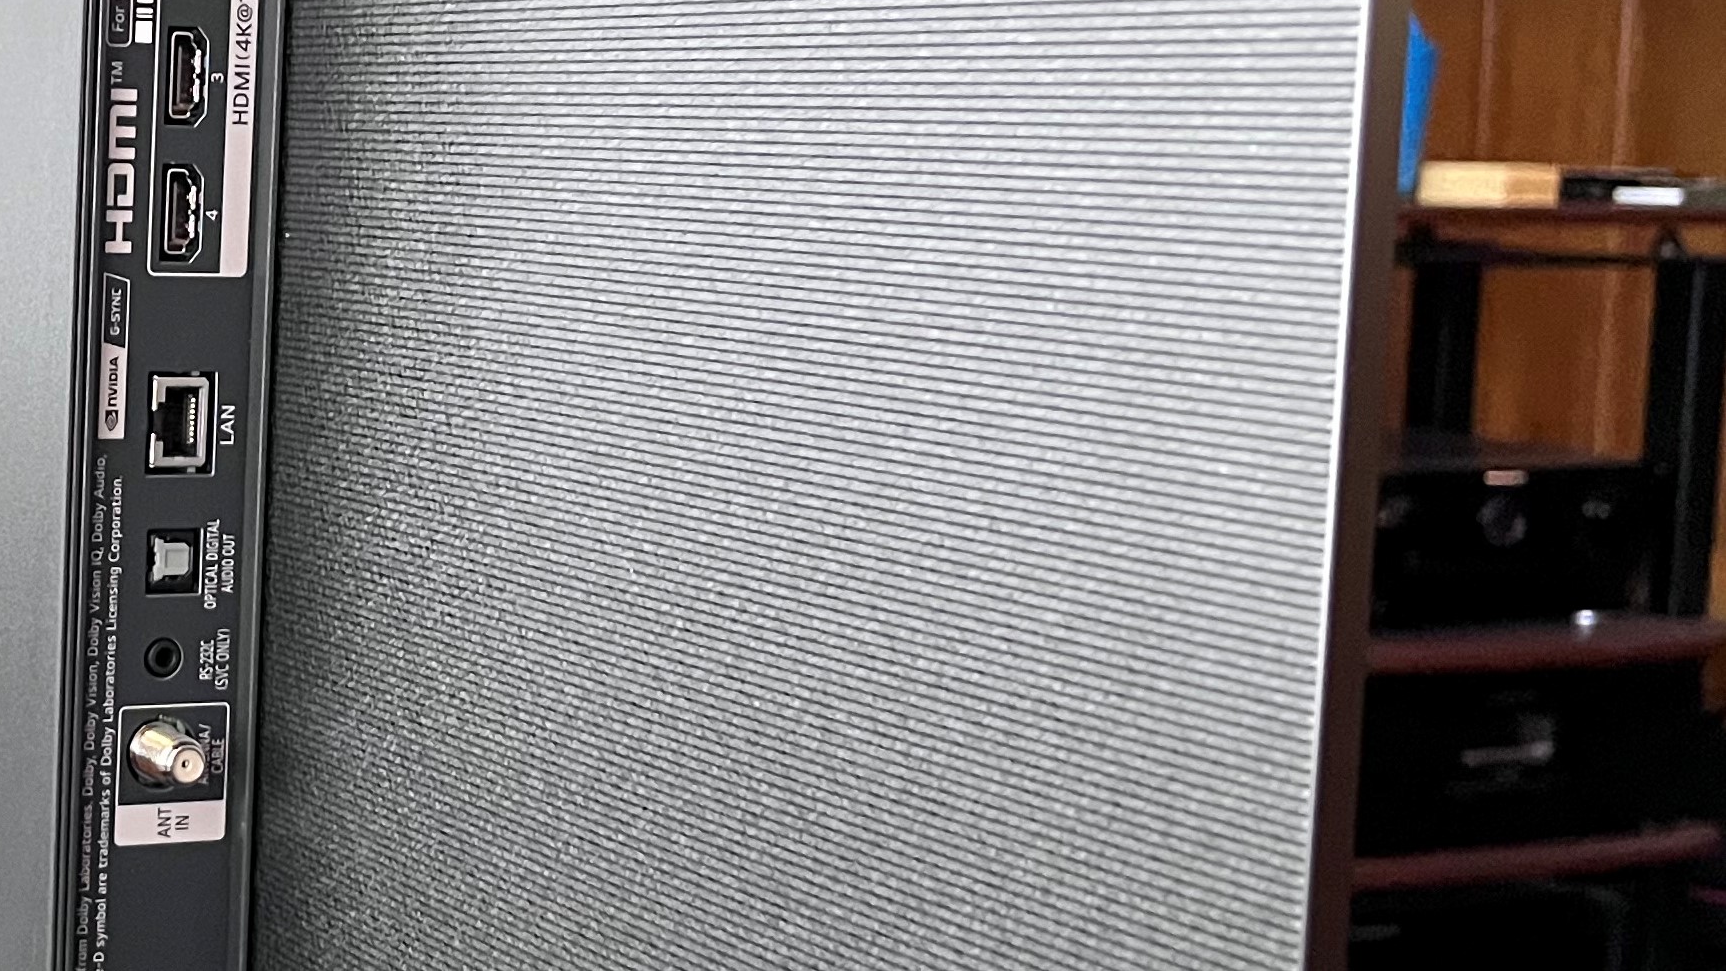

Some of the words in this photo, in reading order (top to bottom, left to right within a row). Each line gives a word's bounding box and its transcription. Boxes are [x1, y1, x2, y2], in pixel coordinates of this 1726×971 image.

[111, 5, 125, 32] For
[210, 72, 224, 83] 3
[205, 209, 219, 221] 4
[109, 287, 122, 336] G-SYNC
[219, 405, 236, 445] LAN
[91, 503, 107, 542] Dolby
[107, 475, 123, 562] Corporation.
[206, 518, 220, 561] DIGITAL
[222, 533, 235, 556] OUT
[89, 570, 102, 613] Vision
[204, 564, 219, 609] OPTICAL
[221, 558, 235, 593] AUDIO
[105, 566, 122, 631] Licensing
[87, 618, 103, 656] Dolby
[215, 628, 231, 661] ONLY)
[102, 635, 117, 723] Laboratories
[199, 639, 214, 680] RS-232C
[215, 664, 229, 690] (SVC
[85, 661, 100, 707] Vision,
[83, 712, 99, 750] Dolby
[100, 727, 116, 766] Dolby
[82, 755, 97, 796] Dolby,
[210, 738, 225, 774] CABLE
[99, 770, 111, 785] of
[97, 789, 111, 868] trademarks
[157, 807, 172, 838] ANT
[175, 815, 190, 831] IN
[98, 872, 108, 894] are
[76, 896, 92, 935] Dolby
[94, 898, 109, 948] symbol
